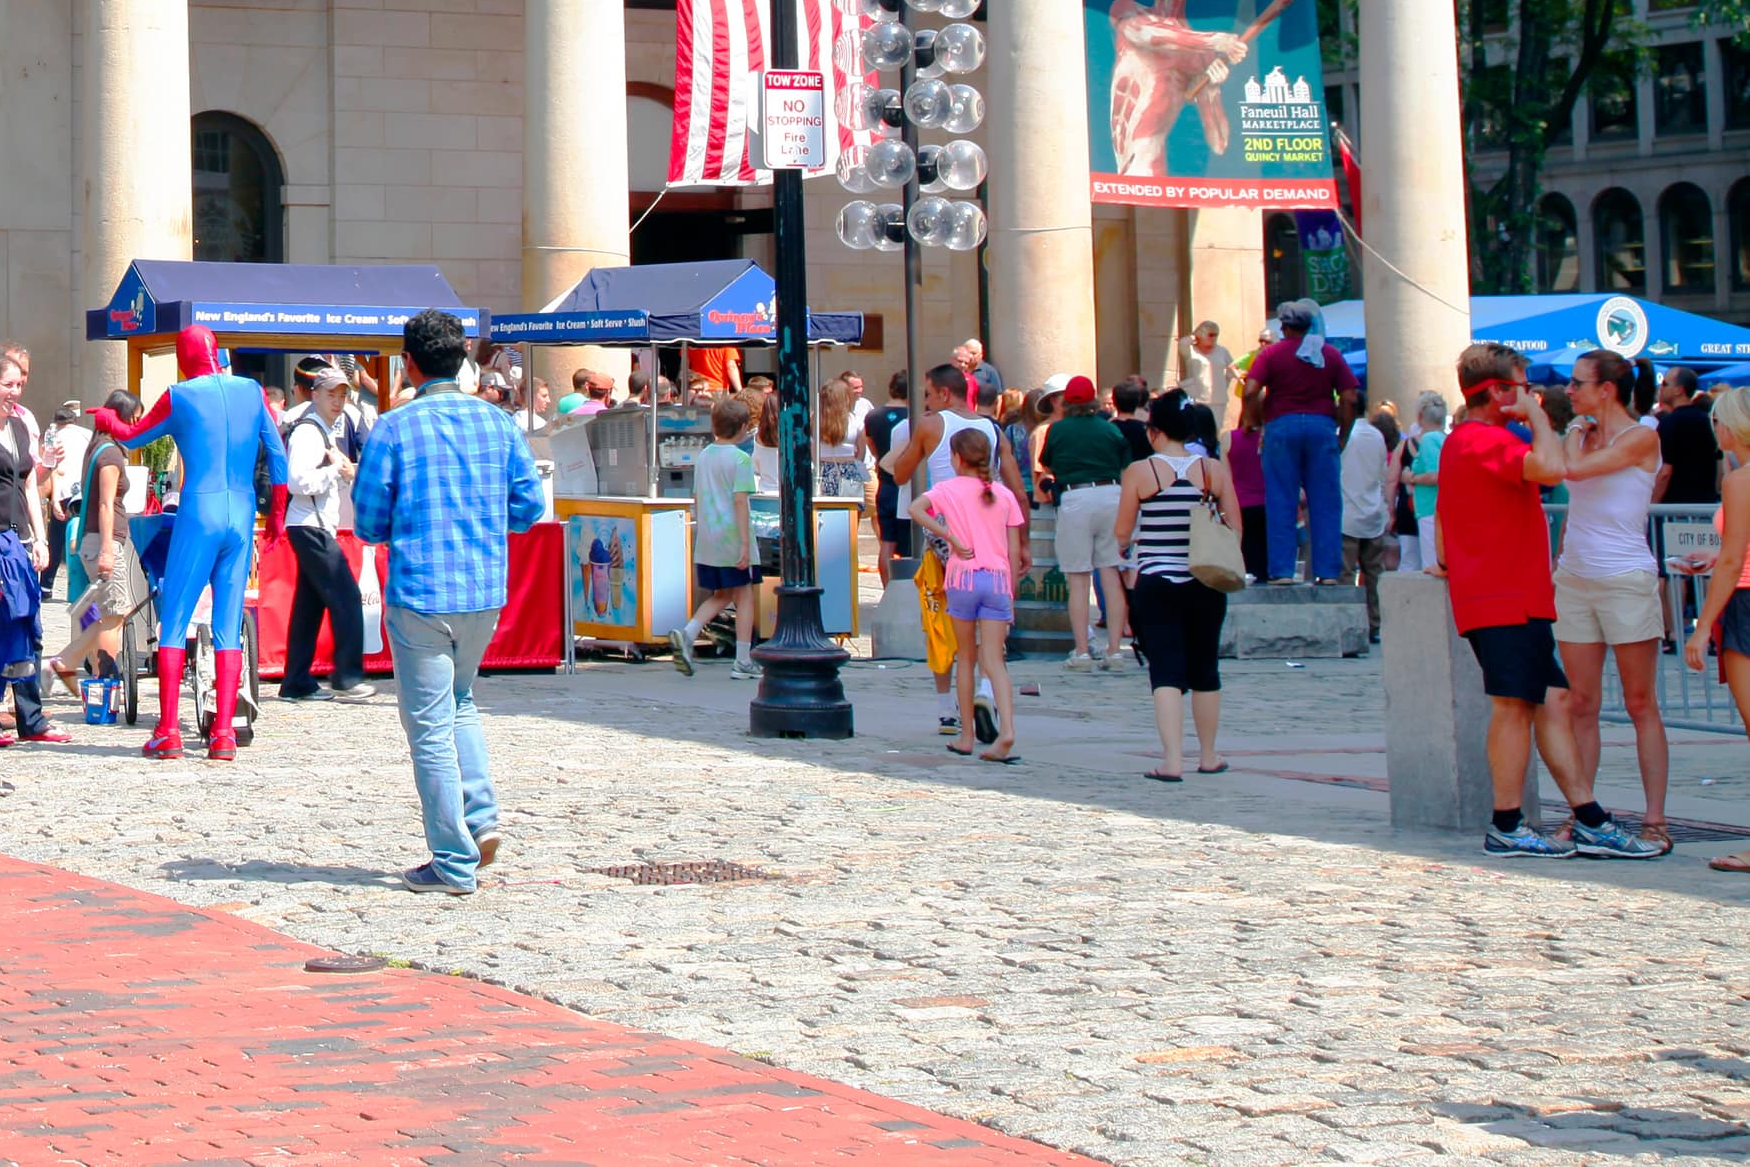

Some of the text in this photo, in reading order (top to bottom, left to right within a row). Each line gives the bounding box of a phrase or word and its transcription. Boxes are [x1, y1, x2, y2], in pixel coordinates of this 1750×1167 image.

[767, 75, 821, 87] TOW ZONE
[784, 100, 805, 113] NO
[1240, 105, 1319, 118] Faneuil Hall
[768, 116, 821, 127] STOPPING
[1242, 120, 1321, 129] MARKETPLACE
[784, 132, 806, 142] Fire
[1244, 138, 1323, 151] 2ND FLOOR
[1245, 152, 1323, 162] QUINCY MARKET
[1093, 181, 1330, 201] EXTENDED BY POPULAR DEMAND
[195, 311, 220, 321] New
[223, 312, 275, 324] England's
[278, 312, 321, 323] Favorite
[326, 313, 342, 324] Ice
[344, 314, 378, 324] Cream
[490, 324, 499, 332] ew
[500, 322, 527, 334] England's
[528, 321, 553, 331] Favorite
[556, 320, 565, 329] Ice
[566, 320, 586, 329] Cream
[590, 319, 603, 328] Soft
[605, 318, 623, 328] Serve
[1503, 339, 1548, 351] SEAFOOD
[1700, 343, 1732, 354] GREAT
[1678, 533, 1694, 545] CITY
[1697, 533, 1706, 545] OF
